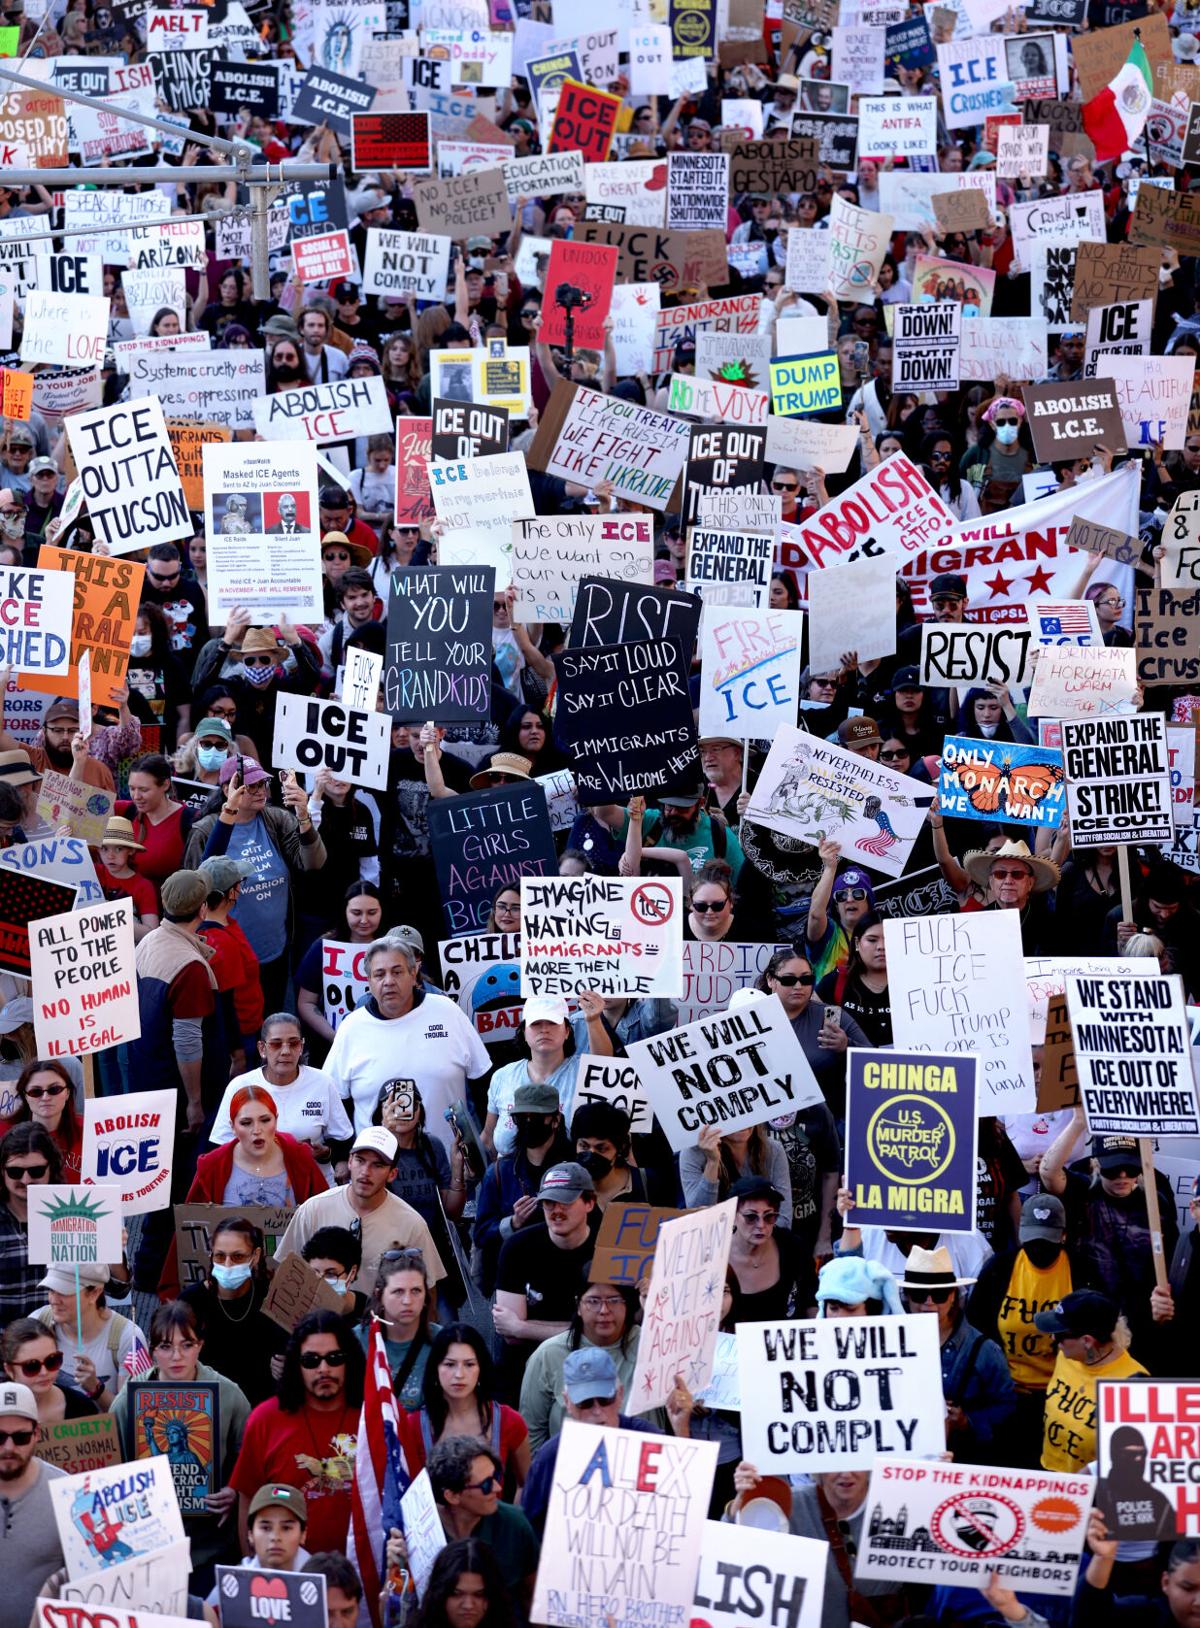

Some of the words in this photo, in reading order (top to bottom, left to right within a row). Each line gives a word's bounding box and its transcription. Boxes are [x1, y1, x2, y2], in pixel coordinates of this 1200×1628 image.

[151, 14, 203, 33] MELT
[214, 71, 276, 88] ABOLISH
[308, 75, 370, 107] ABOLISH
[565, 92, 616, 125] ICE
[866, 103, 885, 112] THIS
[893, 103, 901, 111] IS
[907, 101, 933, 111] WHAT
[555, 117, 610, 149] OUT
[881, 119, 922, 129] ANTIFA
[732, 142, 815, 159] ABOLISH
[868, 141, 897, 150] LOOKS
[503, 155, 581, 180] EDUCATION
[672, 156, 726, 170] MINNESOTA
[762, 160, 793, 169] THE
[420, 186, 438, 203] NO
[446, 177, 478, 197] ICE!
[670, 171, 712, 184] STARTED
[734, 171, 817, 193] GESTAPO
[430, 202, 448, 217] NO
[454, 192, 503, 211] SECRET
[671, 194, 726, 207] NATIONWIDE
[671, 207, 724, 220] SHUTDOWN!
[444, 208, 495, 224] POLICE!
[138, 245, 202, 269] ARIZONA
[379, 233, 401, 248] WE
[408, 235, 440, 254] WILL
[382, 252, 434, 274] NOT
[374, 272, 435, 293] COMPLY
[898, 304, 936, 315] SHUT
[939, 304, 956, 314] IT
[903, 315, 953, 336] DOWN!
[776, 363, 836, 386] DUMP
[576, 389, 603, 408] IF
[604, 400, 634, 419] YOU
[635, 408, 676, 434] TREAT
[774, 388, 840, 416] TRUMP
[1034, 394, 1113, 417] ABOLISH
[81, 409, 157, 455] ICE
[578, 408, 616, 432] LIKE
[621, 419, 680, 450] RUSSIA
[1053, 418, 1104, 439] I.C.E.
[563, 422, 589, 446] WE
[590, 432, 661, 468] FIGHT
[692, 432, 723, 461] ICE
[726, 432, 763, 458] OUT
[81, 446, 180, 498] OUTTA
[223, 470, 254, 478] Masked
[256, 470, 269, 478] ICE
[272, 469, 300, 480] Agents
[552, 446, 598, 478] LIKE
[604, 464, 676, 500] UKRAINE
[712, 459, 736, 484] OF
[91, 489, 189, 543] TUCSON
[514, 518, 551, 540] The
[601, 522, 650, 542] ICE
[692, 532, 745, 556] EXPAND
[747, 538, 771, 558] THE
[690, 554, 768, 586] GENERAL
[392, 574, 441, 597] WHAT
[452, 574, 486, 594] WILL
[410, 597, 470, 633] YOU
[391, 642, 436, 663] TELL
[446, 642, 486, 666] YOUR
[563, 655, 601, 678] SAY
[601, 652, 620, 672] IT
[626, 642, 677, 674] LOUD
[924, 630, 1032, 684] RESIST
[386, 666, 489, 712] GRANDKIDS
[564, 693, 594, 713] SAY
[598, 692, 614, 708] IT
[618, 672, 686, 708] CLEAR
[306, 702, 368, 744] ICE
[1065, 722, 1129, 748] EXPAND
[1130, 717, 1163, 742] THE
[296, 738, 368, 776] OUT
[570, 726, 690, 760] IMMIGRANTS
[942, 744, 994, 768] ONLY
[578, 771, 602, 790] ARE
[598, 761, 668, 792] WELCOME
[667, 744, 699, 775] HERE
[813, 748, 901, 792] NEVERTHELESS
[1068, 742, 1165, 780] GENERAL
[808, 773, 864, 802] RESISTED
[835, 772, 856, 785] SHE
[943, 771, 1064, 802] MONARCH
[941, 794, 968, 813] WE
[1004, 800, 1058, 822] WANT
[1077, 781, 1162, 817] STRIKE!
[1072, 818, 1109, 831] ICE
[1112, 814, 1169, 830] OUT!
[38, 928, 73, 948] ALL
[79, 909, 127, 937] POWER
[50, 947, 78, 966] TO
[82, 935, 118, 956] THE
[54, 957, 122, 989] PEOPLE
[525, 962, 569, 975] MORE
[575, 959, 620, 972] THEN
[42, 998, 70, 1019] NO
[82, 980, 131, 1011] HUMAN
[1077, 979, 1107, 1008] WE
[1109, 980, 1172, 1009] STAND
[80, 1014, 96, 1030] IS
[428, 1024, 444, 1032] GOOD
[1100, 1012, 1154, 1022] WITH
[48, 1026, 124, 1058] ILLEGAL
[424, 1031, 448, 1039] TROUBLE
[647, 1032, 698, 1068] WE
[701, 1010, 772, 1049] WILL
[1077, 1024, 1184, 1053] MINNESOTA!
[672, 1041, 770, 1100] NOT
[863, 1062, 958, 1093] CHINGA
[1090, 1059, 1117, 1086] ICE
[1119, 1060, 1151, 1087] OUT
[1156, 1061, 1178, 1087] OF
[677, 1074, 796, 1132] COMPLY
[1085, 1089, 1195, 1116] EVERYWHERE!
[94, 1112, 160, 1136] ABOLISH
[898, 1110, 925, 1124] U.S.
[876, 1128, 942, 1143] MURDER
[96, 1136, 160, 1177] ICE
[880, 1145, 941, 1160] PATROL
[136, 1168, 170, 1197] TOGETHER
[856, 1184, 883, 1209] LA
[888, 1186, 964, 1214] MIGRA
[50, 1219, 97, 1232] IMMIGRATION
[51, 1233, 75, 1244] BUILT
[78, 1232, 97, 1244] THIS
[51, 1244, 97, 1262] NATION
[763, 1328, 819, 1361] WE
[834, 1325, 917, 1359] WILL
[140, 1391, 209, 1411] RESIST
[780, 1367, 903, 1413] NOT
[767, 1419, 918, 1455] COMPLY
[92, 1468, 155, 1513] ABOLISH
[883, 1466, 927, 1481] STOP
[933, 1470, 964, 1485] THE
[969, 1474, 1088, 1496] KIDNAPPINGS
[867, 1553, 935, 1570] PROTECT
[940, 1559, 980, 1574] YOUR
[985, 1564, 1072, 1581] NEIGHBORS
[251, 1596, 292, 1621] LOVE
